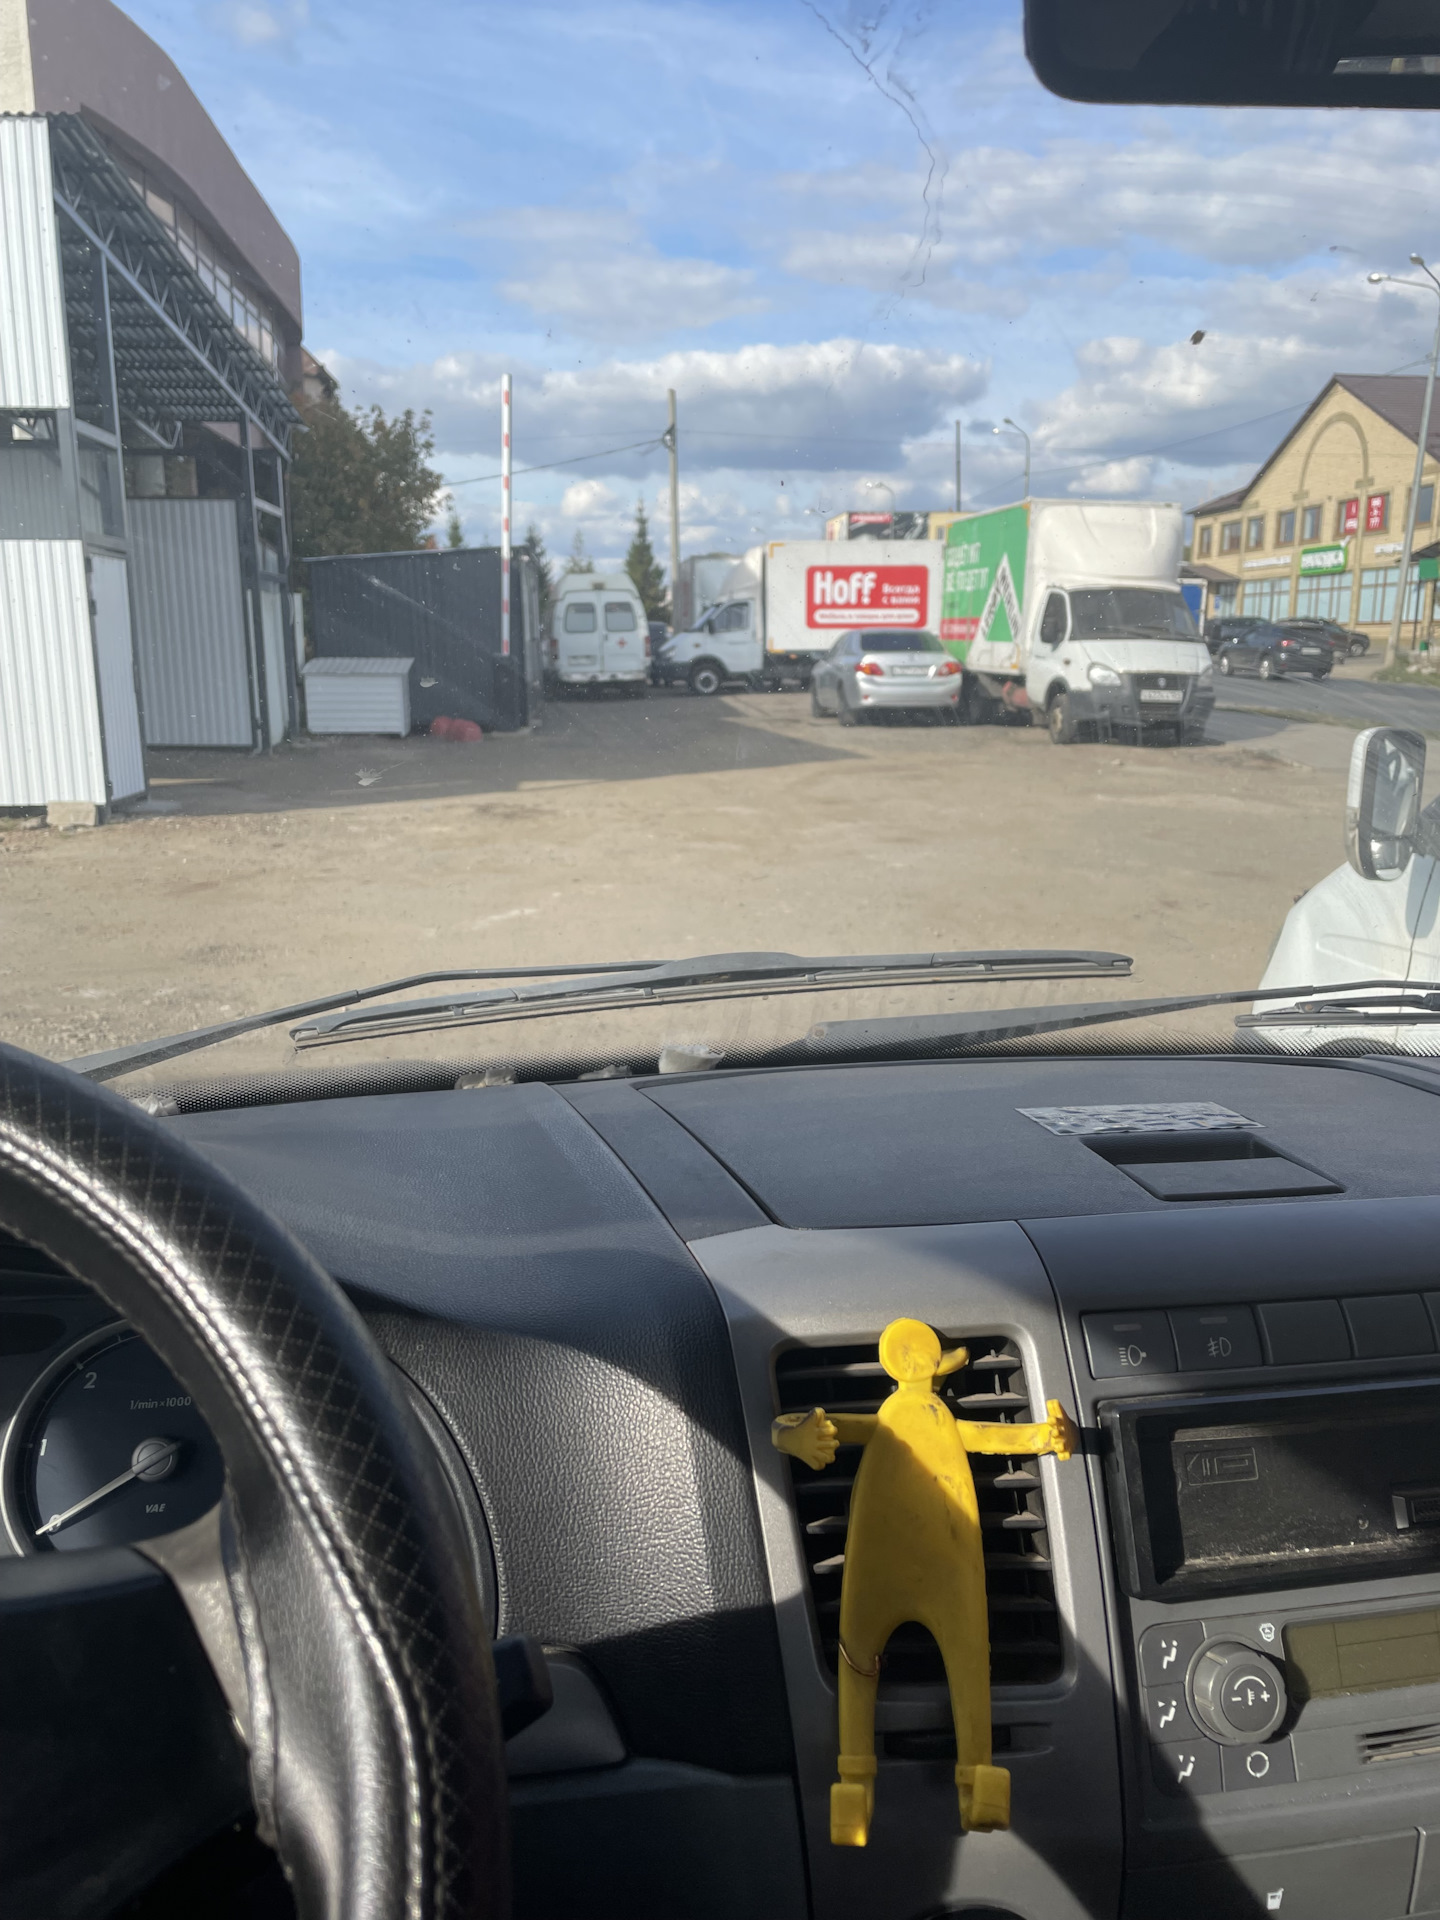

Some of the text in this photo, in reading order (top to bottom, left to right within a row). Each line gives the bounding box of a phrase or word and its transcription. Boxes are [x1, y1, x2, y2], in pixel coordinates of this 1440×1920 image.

[813, 570, 878, 605] Hoff
[83, 1371, 97, 1389] 2
[40, 1438, 47, 1456] 1
